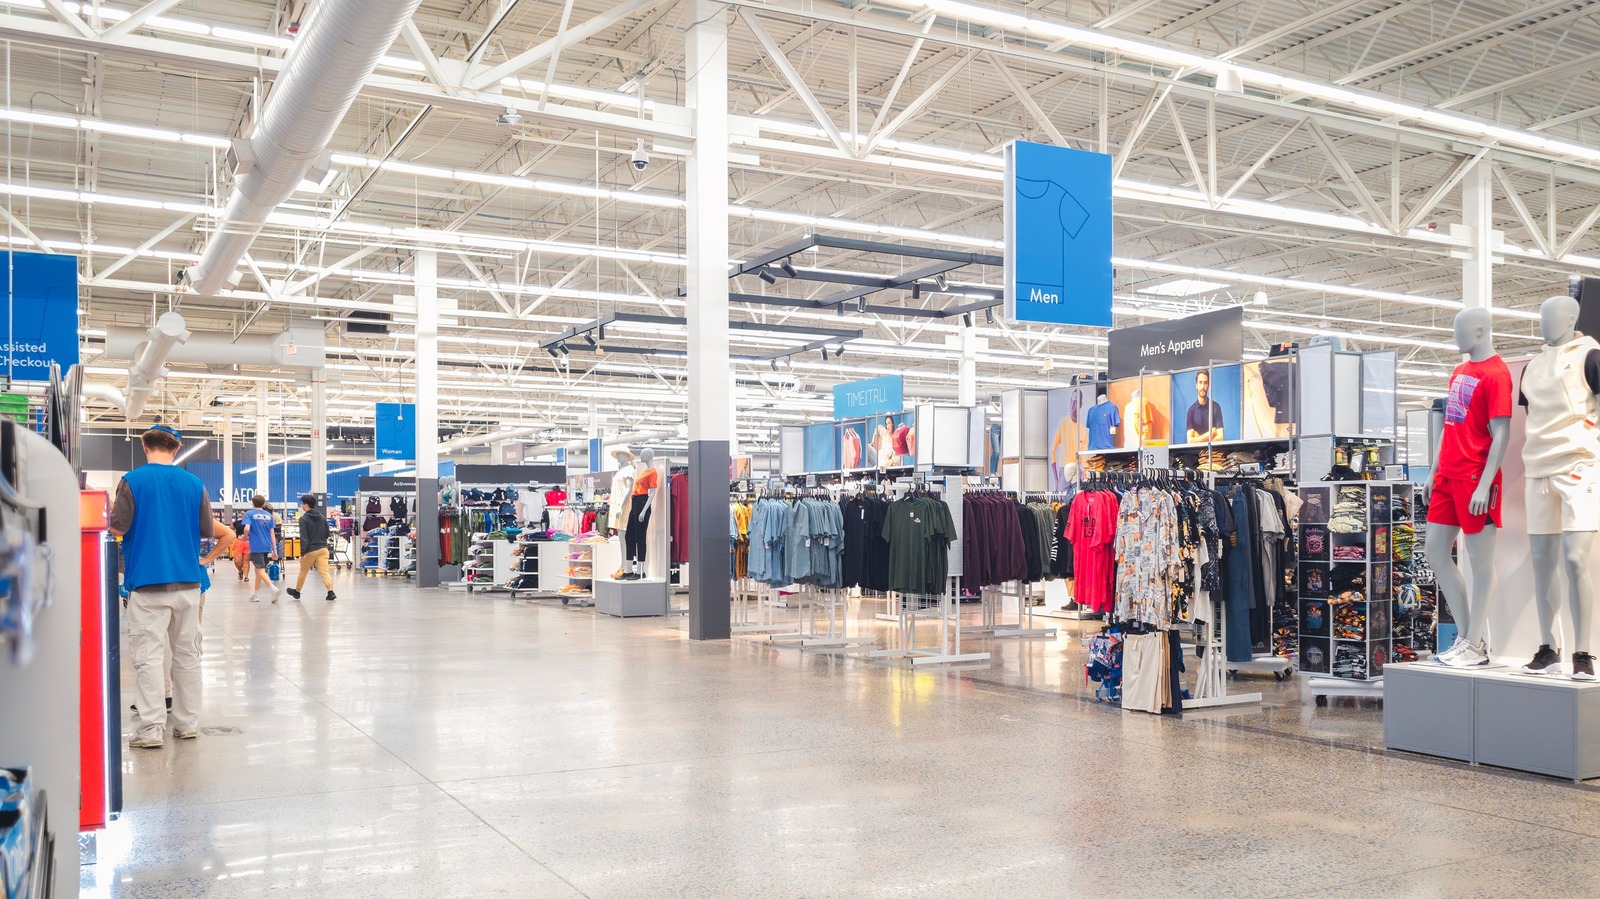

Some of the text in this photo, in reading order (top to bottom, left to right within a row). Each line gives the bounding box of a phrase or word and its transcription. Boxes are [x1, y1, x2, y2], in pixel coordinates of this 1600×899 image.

[1030, 287, 1058, 304] Men
[1140, 334, 1204, 357] Men's Apparel
[846, 390, 865, 407] TIME
[1143, 454, 1155, 465] $13
